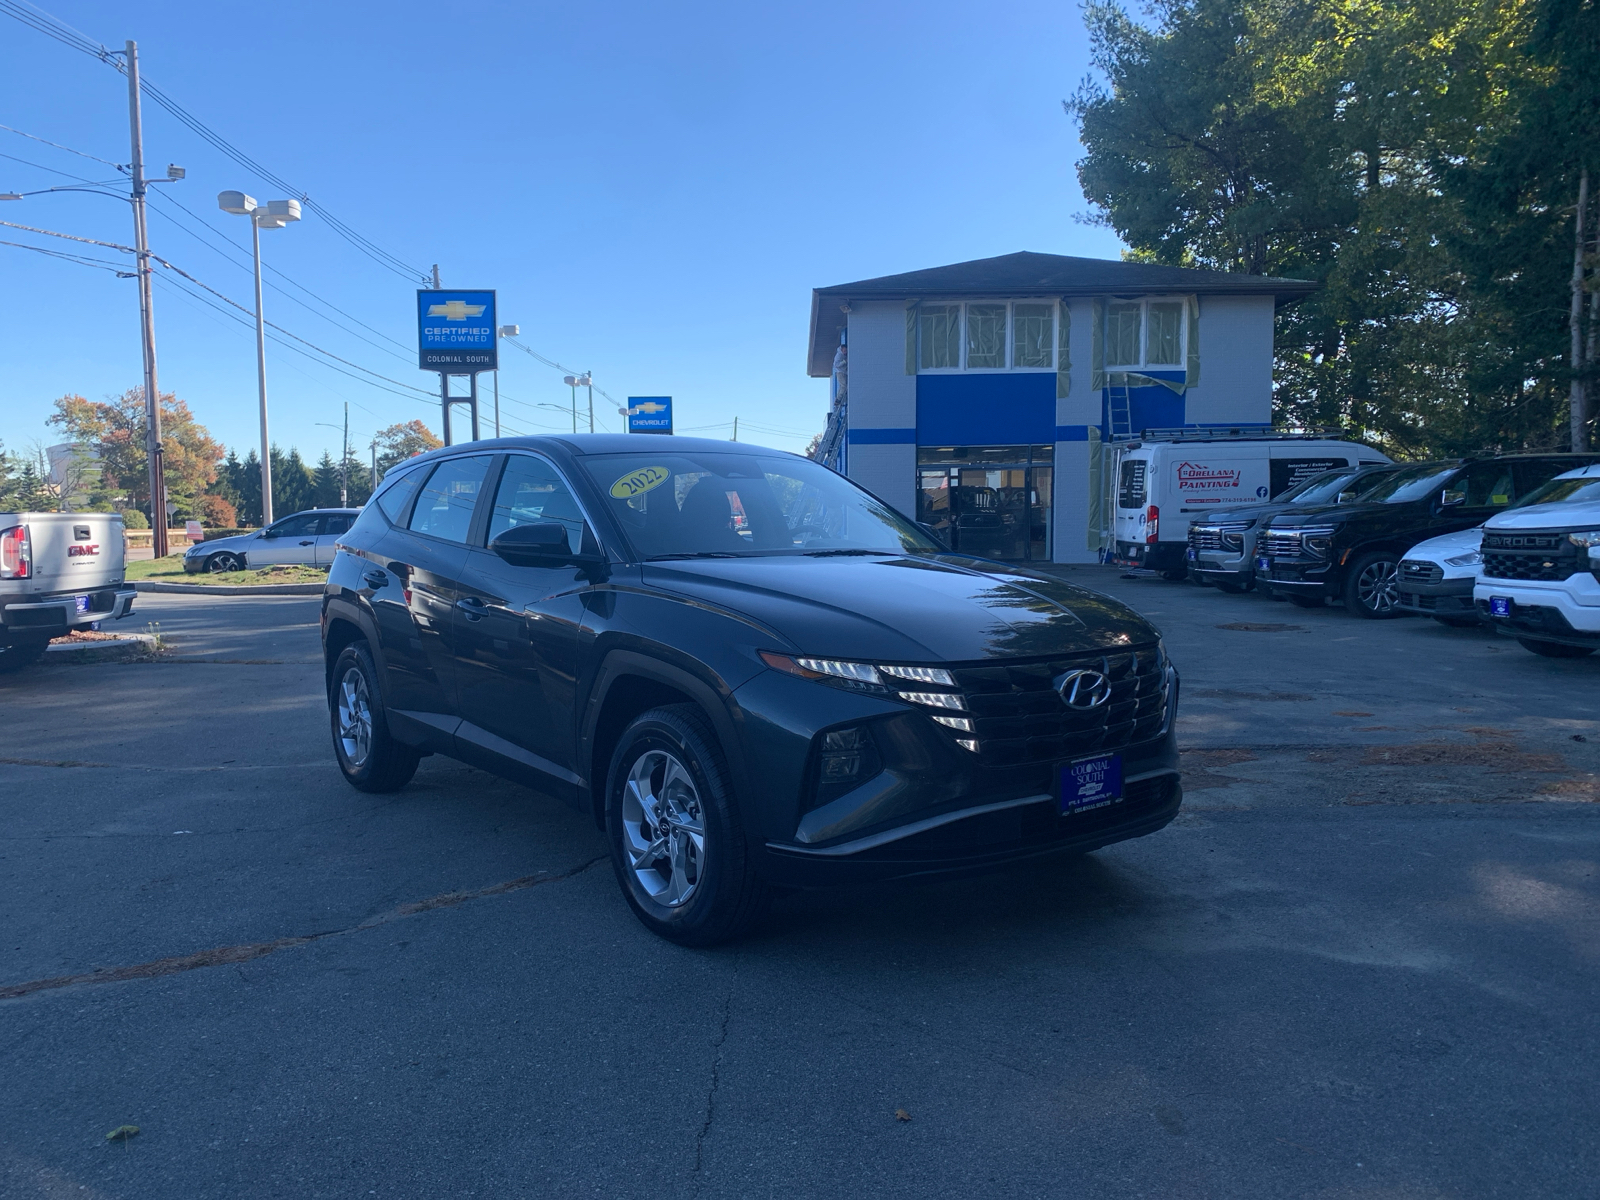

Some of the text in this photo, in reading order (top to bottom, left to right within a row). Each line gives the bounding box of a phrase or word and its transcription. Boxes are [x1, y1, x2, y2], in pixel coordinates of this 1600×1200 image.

[424, 327, 490, 335] CERTIFIED
[427, 355, 489, 363] COLONIAL SOUTH
[1188, 469, 1235, 477] ORELLANA
[621, 468, 662, 495] 2022
[1179, 480, 1231, 489] PAINTING
[67, 544, 100, 557] GMC
[1071, 760, 1110, 776] COLONIAL
[1077, 771, 1104, 785] SOUTH
